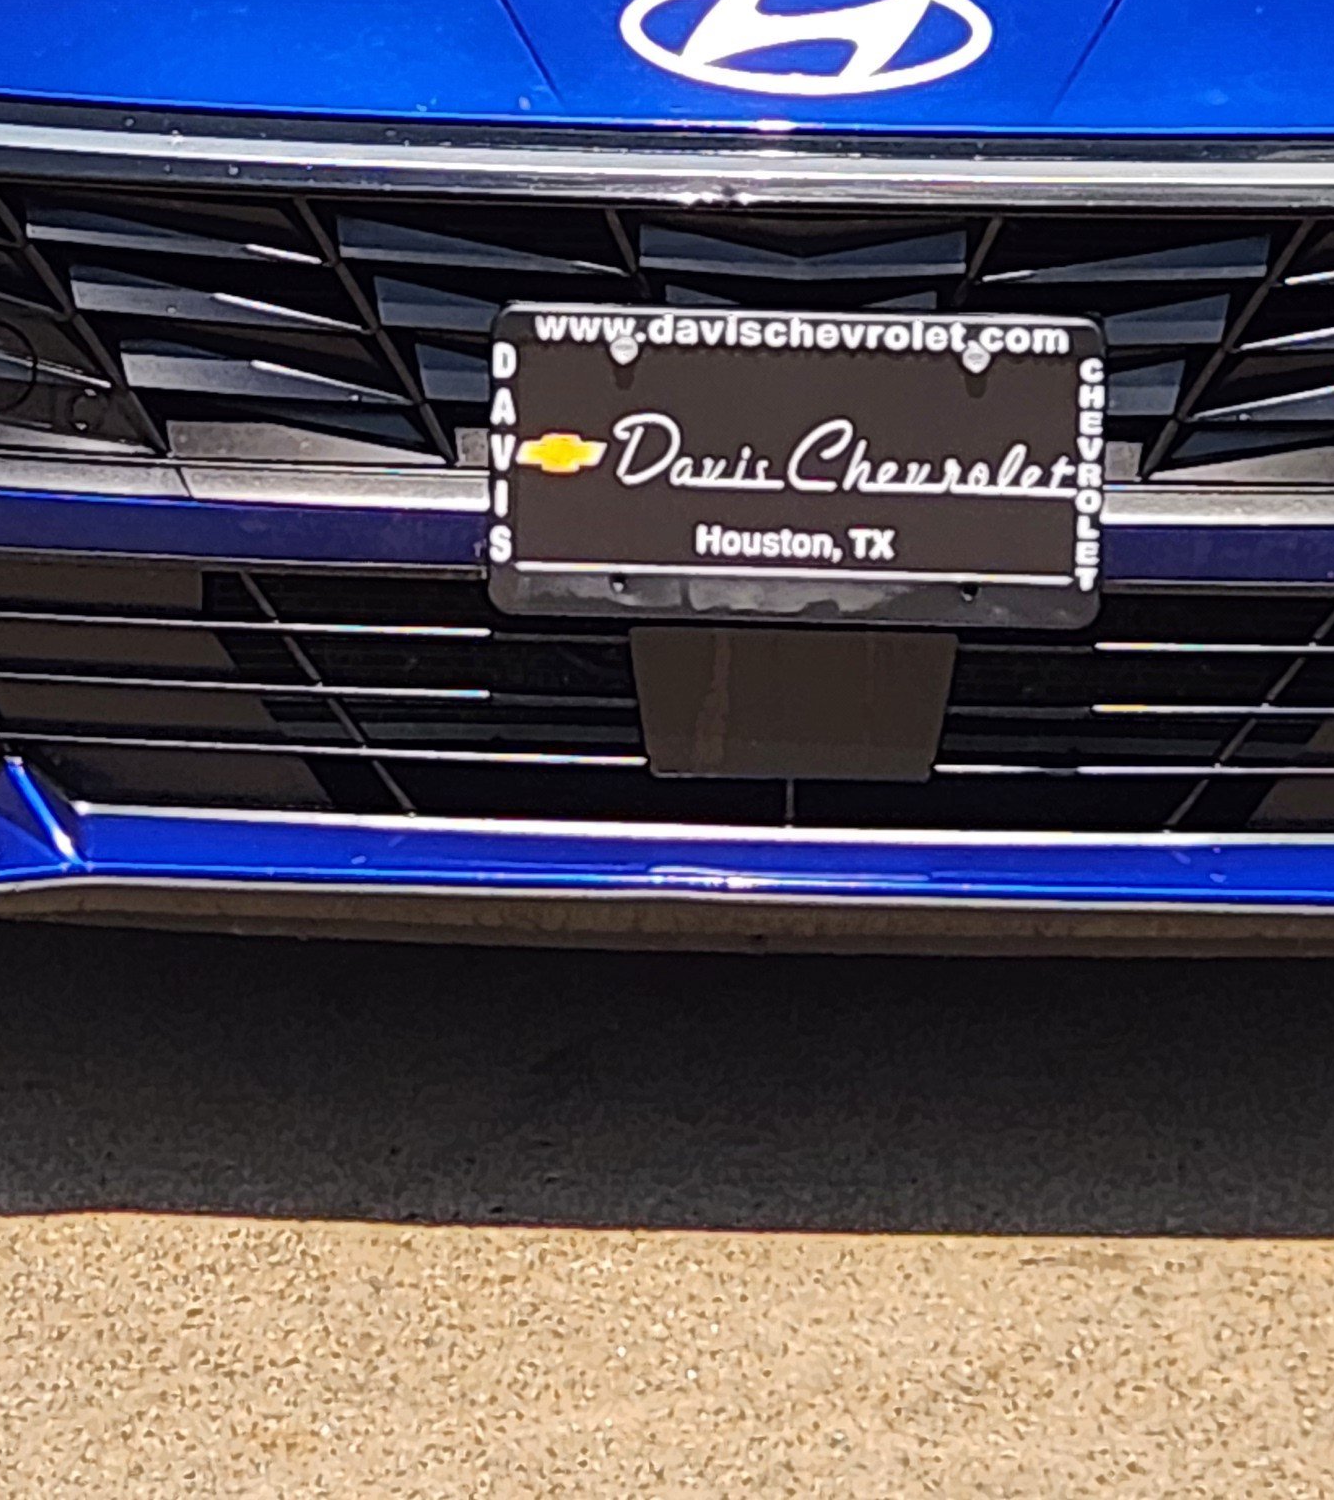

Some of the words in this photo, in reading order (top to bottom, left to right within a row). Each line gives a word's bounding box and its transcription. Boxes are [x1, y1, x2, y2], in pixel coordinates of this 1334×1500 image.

[489, 341, 517, 563] DAVIS
[612, 412, 785, 491] Davis
[786, 418, 1080, 498] Chevrolet
[1074, 357, 1105, 592] CHEVROLET
[695, 523, 844, 563] Houston,
[848, 527, 895, 561] TX
